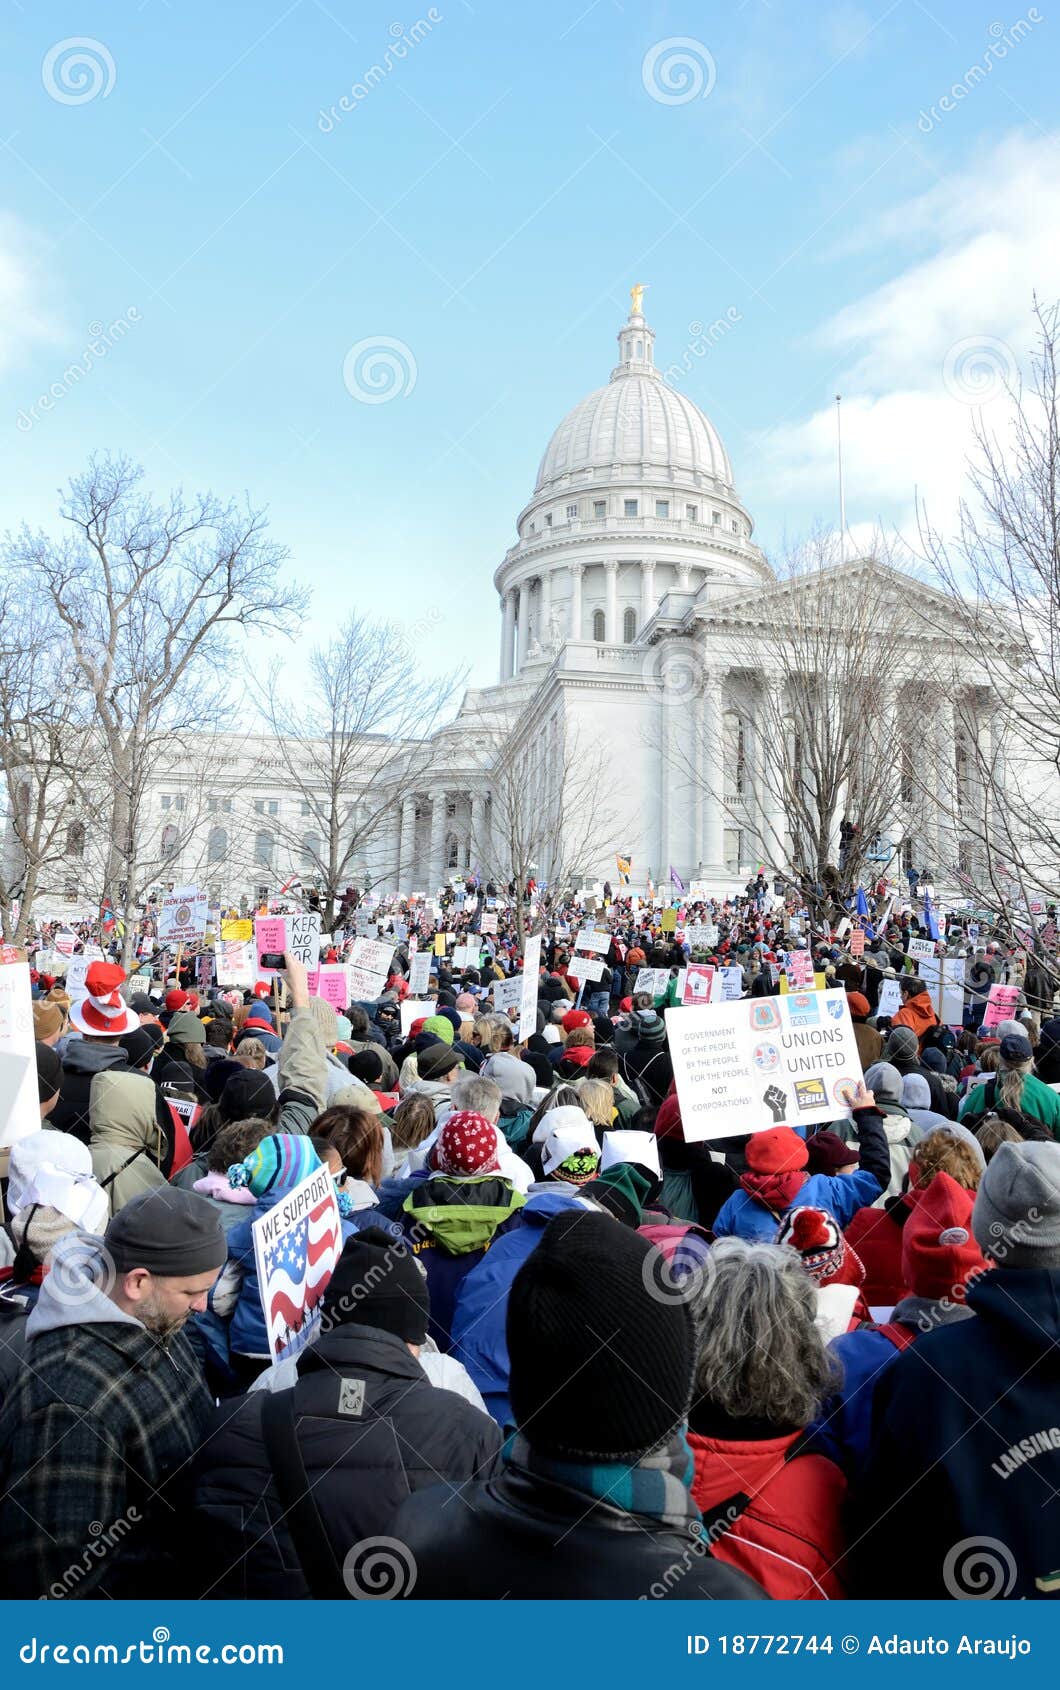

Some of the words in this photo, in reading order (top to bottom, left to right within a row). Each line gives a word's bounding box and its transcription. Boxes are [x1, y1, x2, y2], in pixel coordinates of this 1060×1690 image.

[291, 916, 318, 933] KER
[292, 933, 312, 946] NO
[684, 1027, 736, 1041] GOVERNMENT
[781, 1028, 844, 1049] UNIONS
[681, 1047, 691, 1056] OF
[693, 1045, 708, 1053] THE
[709, 1042, 737, 1052] PEOPLE
[697, 1058, 711, 1067] THE
[712, 1055, 741, 1065] PEOPLE
[787, 1052, 846, 1073] UNITED
[722, 1067, 751, 1078] PEOPLE
[711, 1086, 728, 1095] NOT
[799, 1092, 825, 1105] SEIU
[262, 1213, 281, 1244] WE
[283, 1170, 329, 1228] SUPPORT
[991, 1427, 1060, 1480] LANSING
